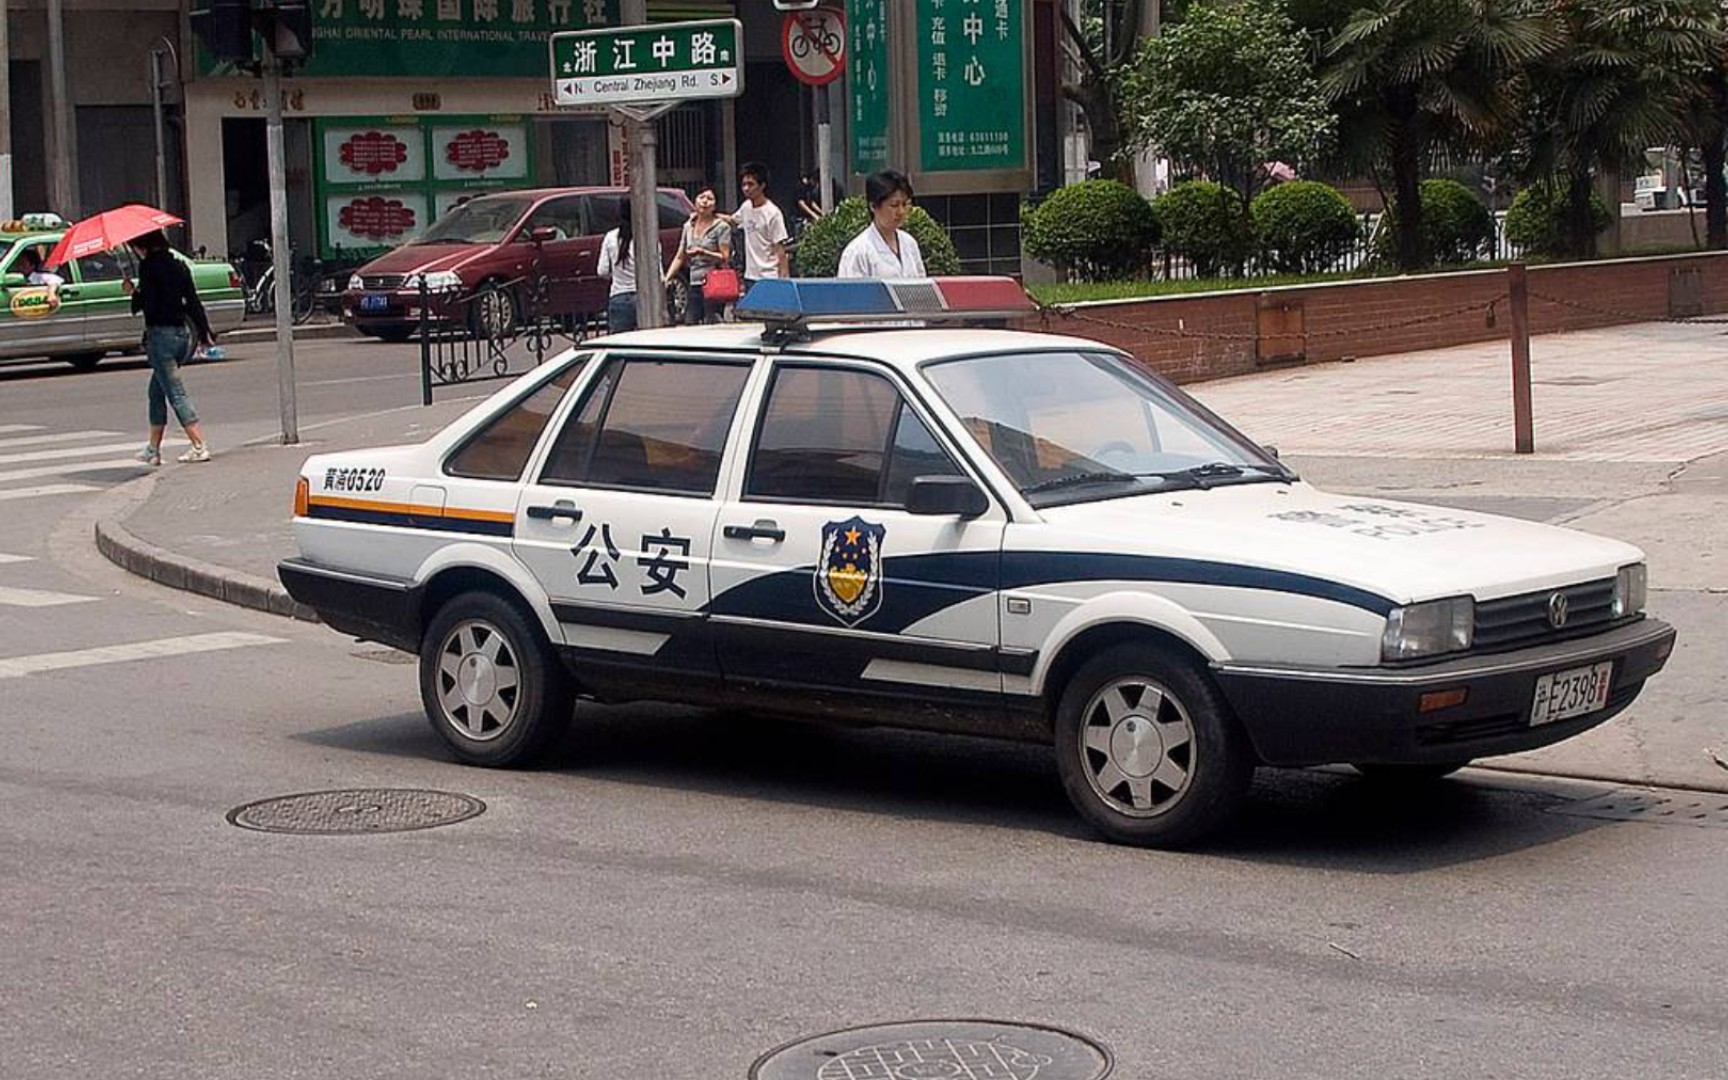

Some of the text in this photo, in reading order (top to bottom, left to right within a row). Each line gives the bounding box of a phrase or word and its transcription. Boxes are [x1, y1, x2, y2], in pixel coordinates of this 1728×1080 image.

[345, 27, 397, 39] ORIENTAL
[401, 28, 433, 40] PEARL
[437, 29, 515, 42] INTERNATIONAL
[573, 31, 717, 73] 浙江中路
[594, 81, 629, 94] Central
[634, 78, 676, 93] Zhejiang
[681, 75, 699, 88] Rd.
[323, 467, 386, 491] 黄浦0520
[570, 522, 691, 600] 公安
